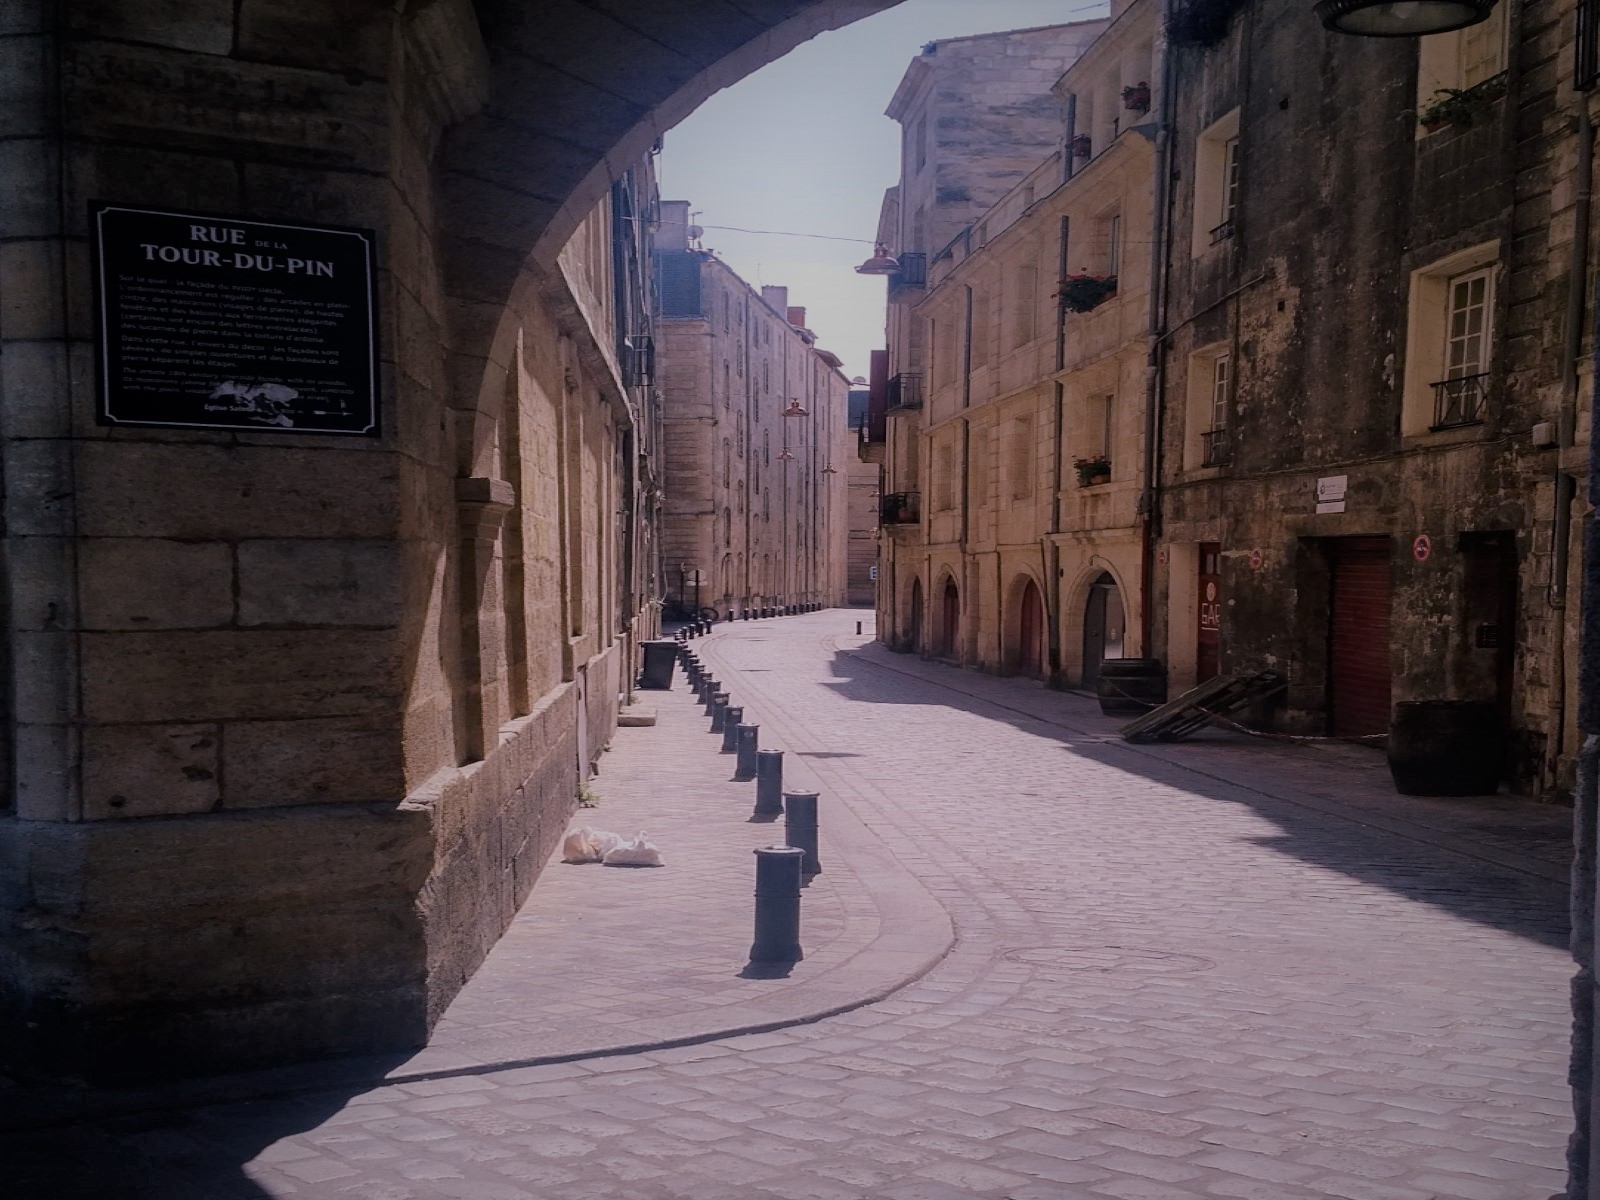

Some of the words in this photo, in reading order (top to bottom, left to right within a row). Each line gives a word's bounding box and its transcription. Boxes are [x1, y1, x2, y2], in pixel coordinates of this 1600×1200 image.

[190, 224, 246, 245] RUE
[254, 239, 271, 248] DE
[139, 243, 334, 278] TOUR-DU-PIN
